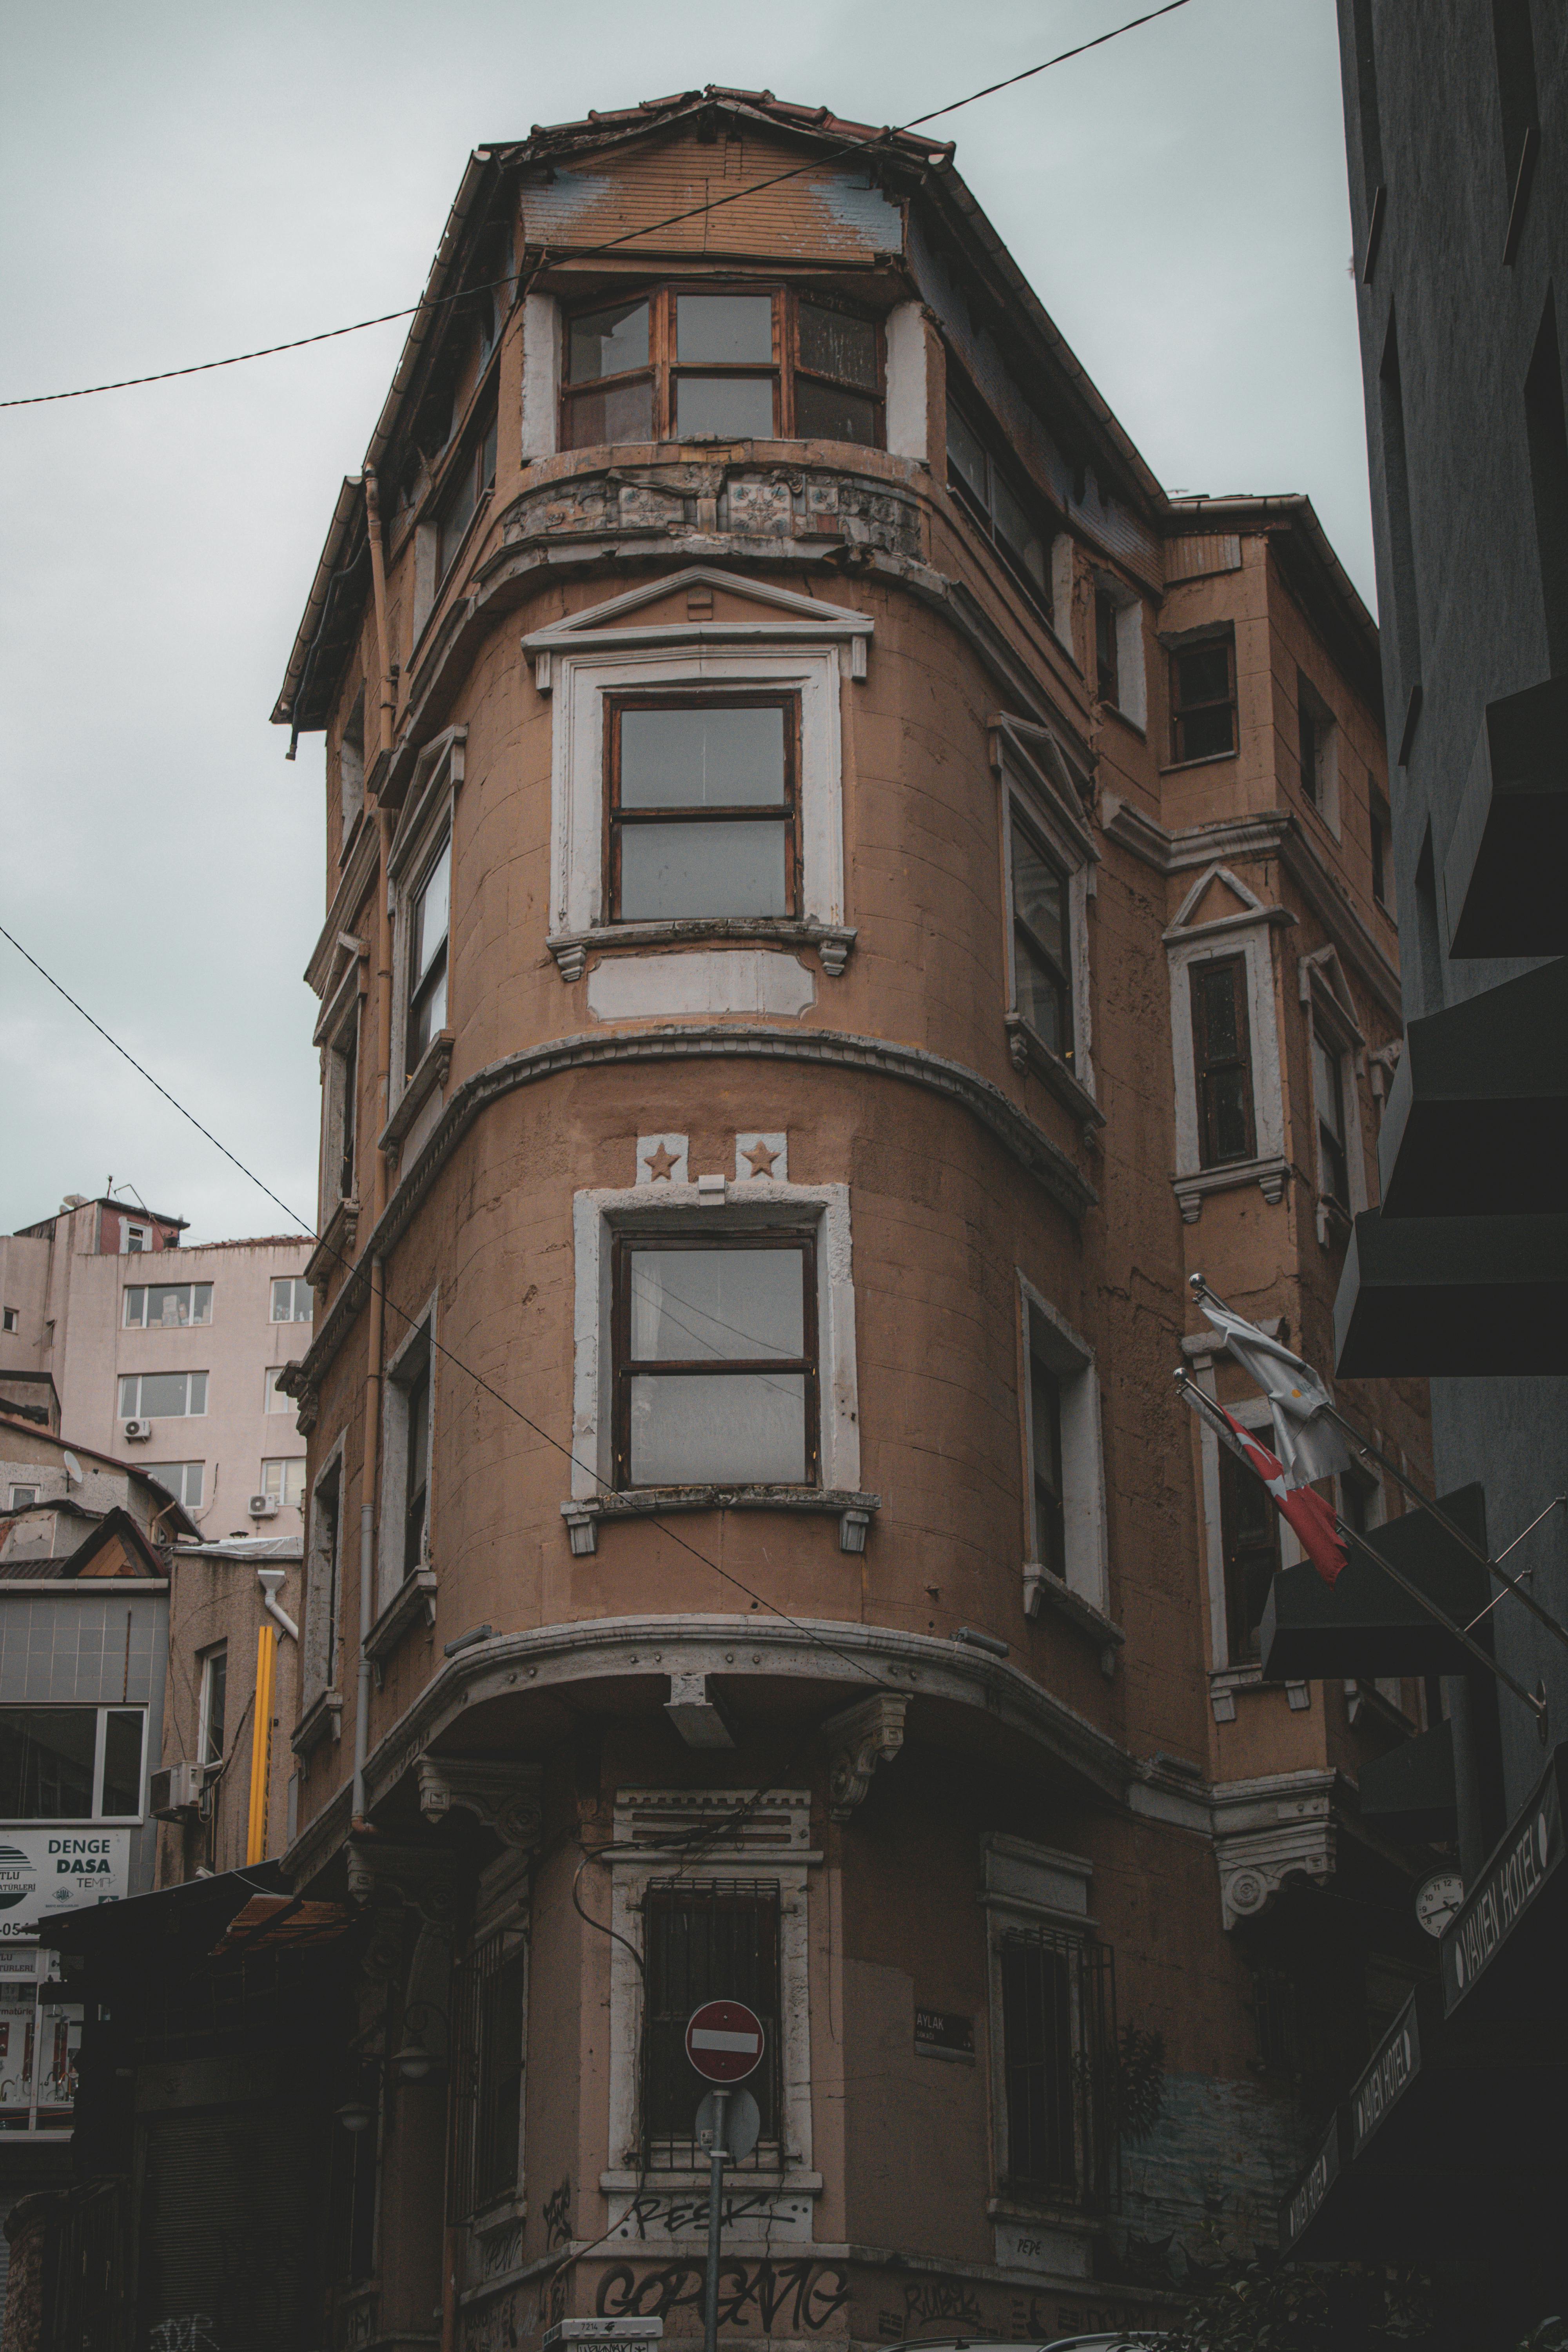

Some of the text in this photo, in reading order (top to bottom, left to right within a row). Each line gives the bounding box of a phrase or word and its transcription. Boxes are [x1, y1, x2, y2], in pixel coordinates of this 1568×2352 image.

[49, 1840, 110, 1853] DENGE
[57, 1859, 111, 1873] DASA
[56, 1889, 69, 1900] GAMA
[1462, 1825, 1541, 1981] VAVIEN HOTEL
[917, 2013, 944, 2031] AYLAK
[1362, 2034, 1406, 2134] VAVIEN HOTEL
